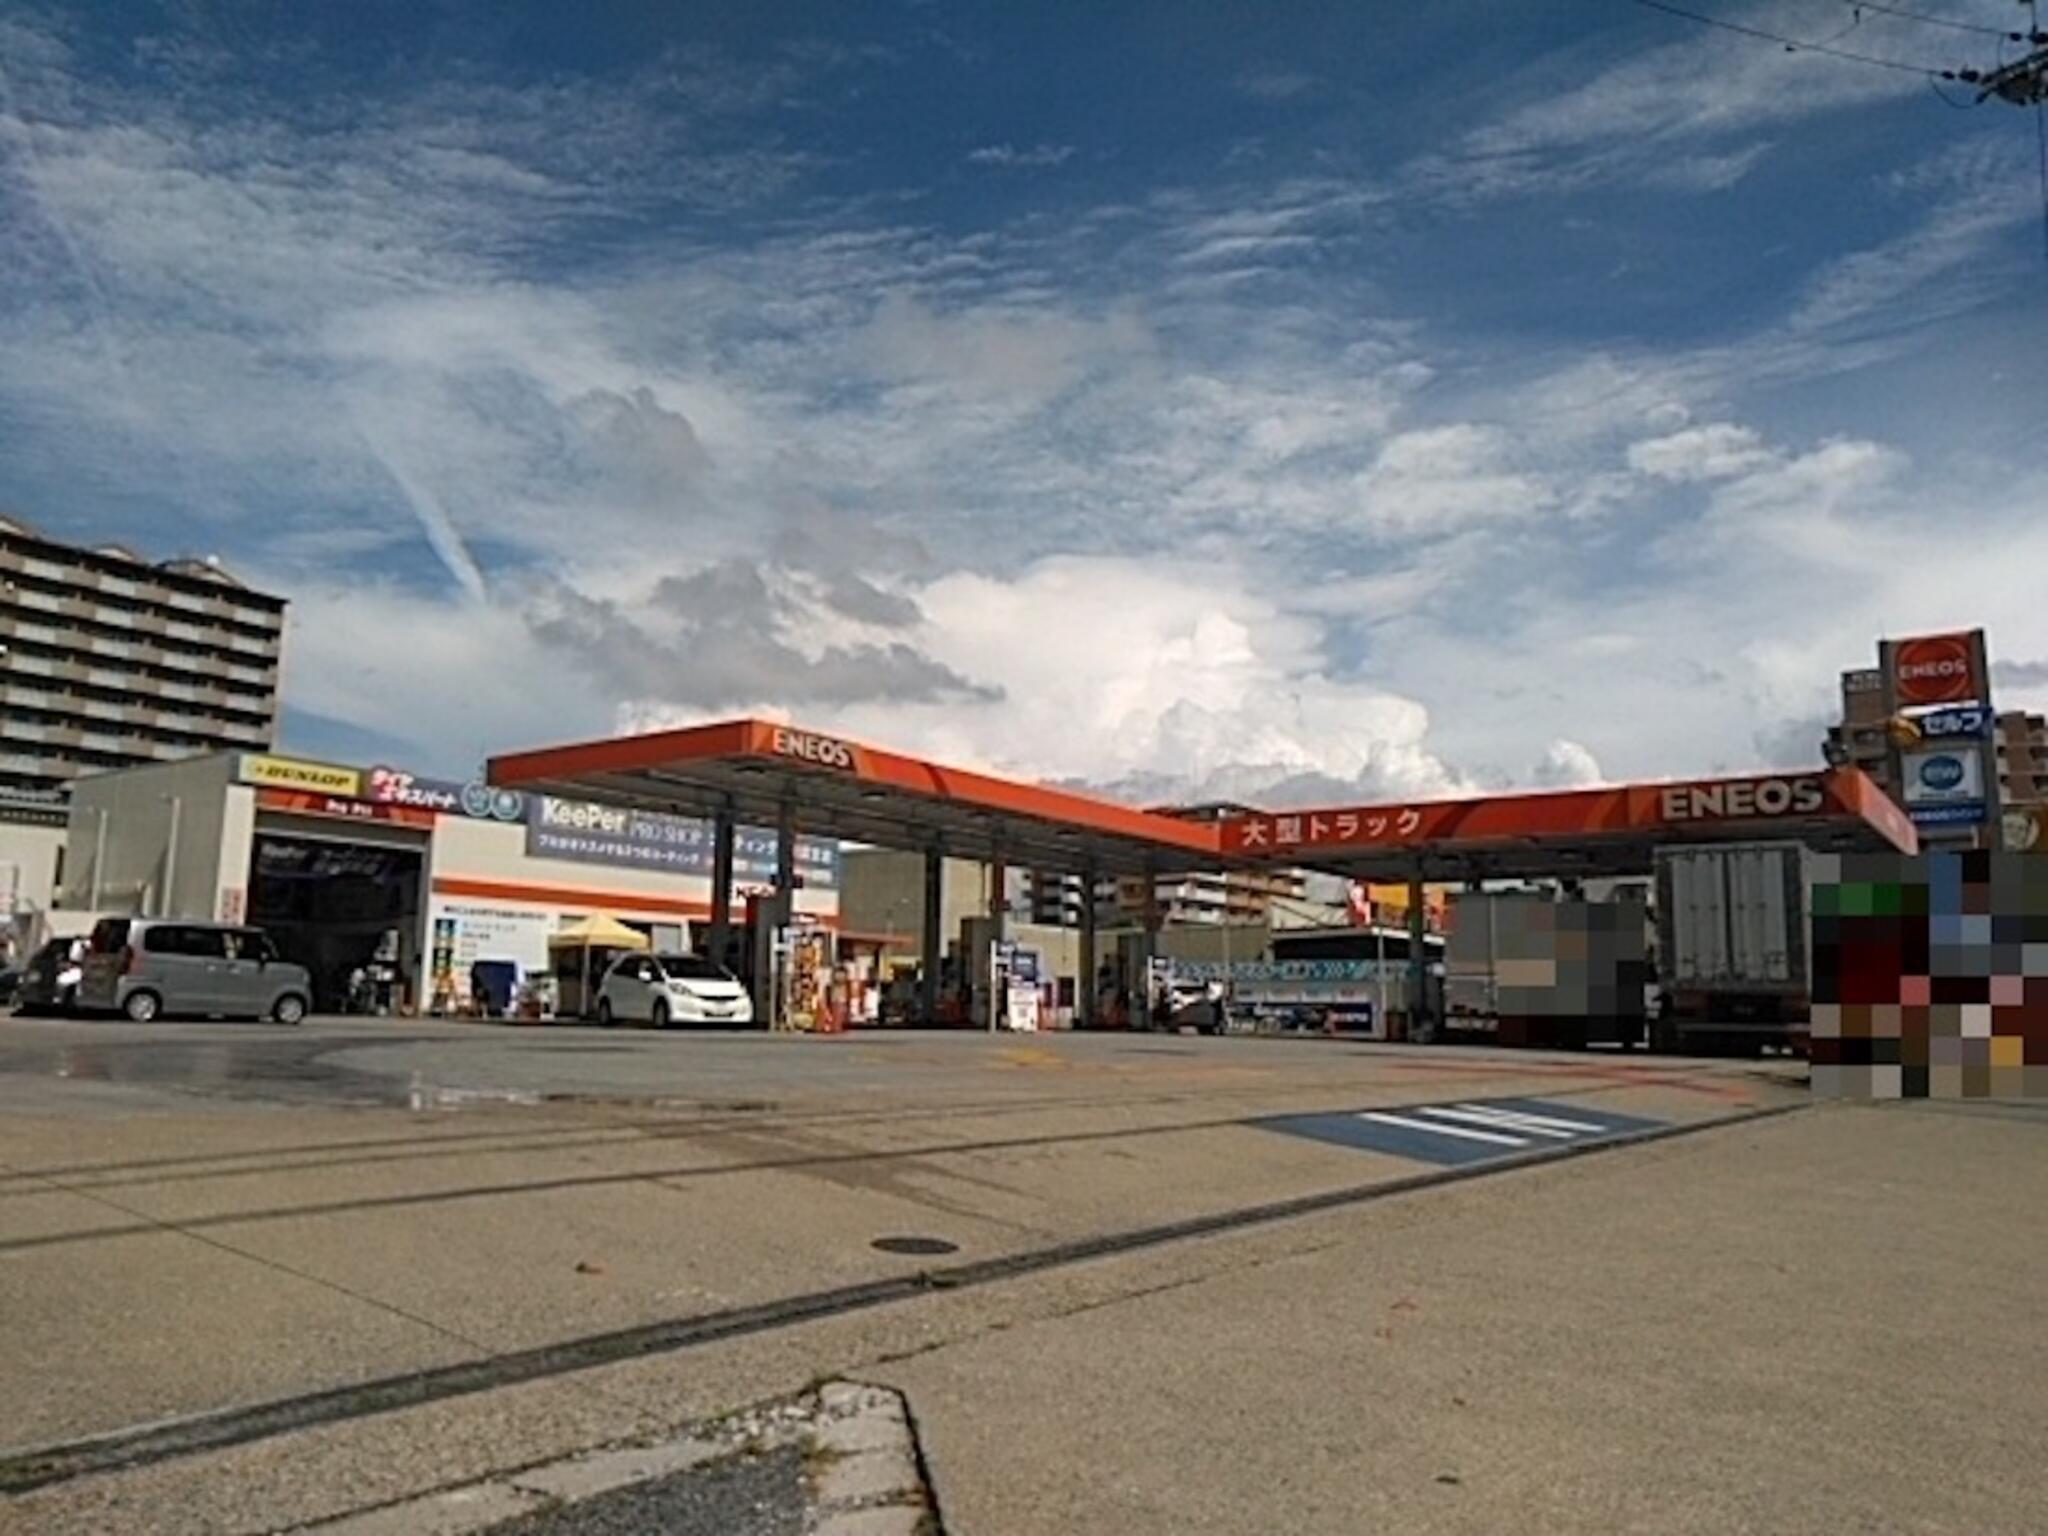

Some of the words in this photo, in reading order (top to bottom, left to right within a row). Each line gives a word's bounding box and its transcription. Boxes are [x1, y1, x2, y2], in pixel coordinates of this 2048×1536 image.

[1899, 659, 1967, 680] ENEOS
[1922, 712, 1982, 735] セルフ
[773, 729, 849, 768] ENEOS
[265, 766, 350, 786] DUNLOP
[541, 798, 626, 833] KeePer
[1661, 779, 1824, 821] ENEOS
[1242, 808, 1421, 847] 大型トラック
